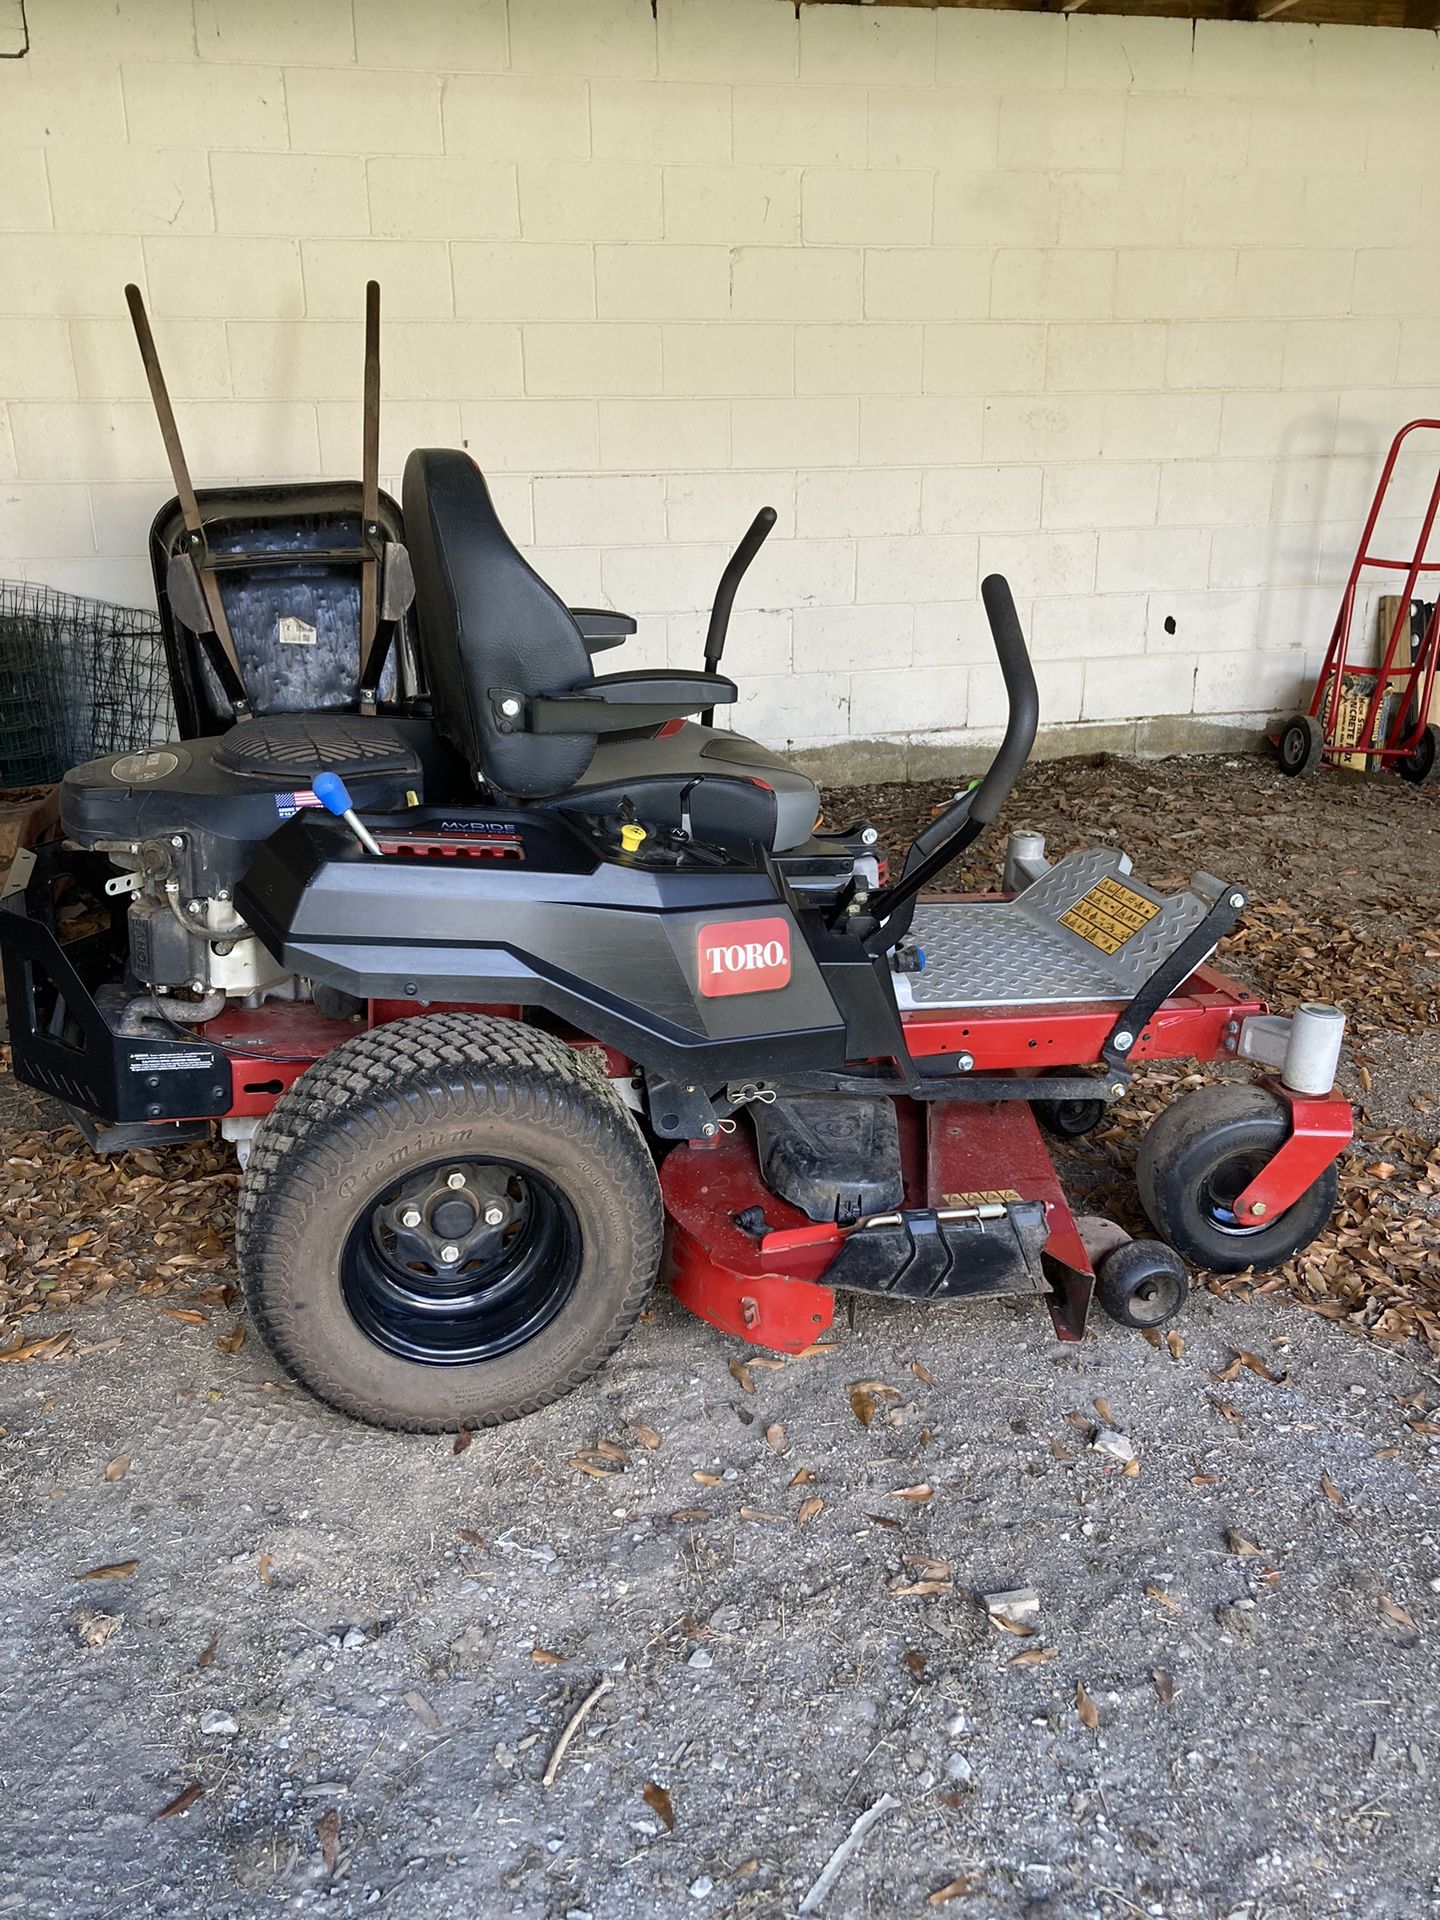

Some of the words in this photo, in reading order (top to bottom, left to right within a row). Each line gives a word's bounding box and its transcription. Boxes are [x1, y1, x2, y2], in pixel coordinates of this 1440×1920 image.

[1345, 693, 1359, 740] ONCRETE
[706, 940, 785, 974] TORO
[338, 1127, 474, 1200] Premium
